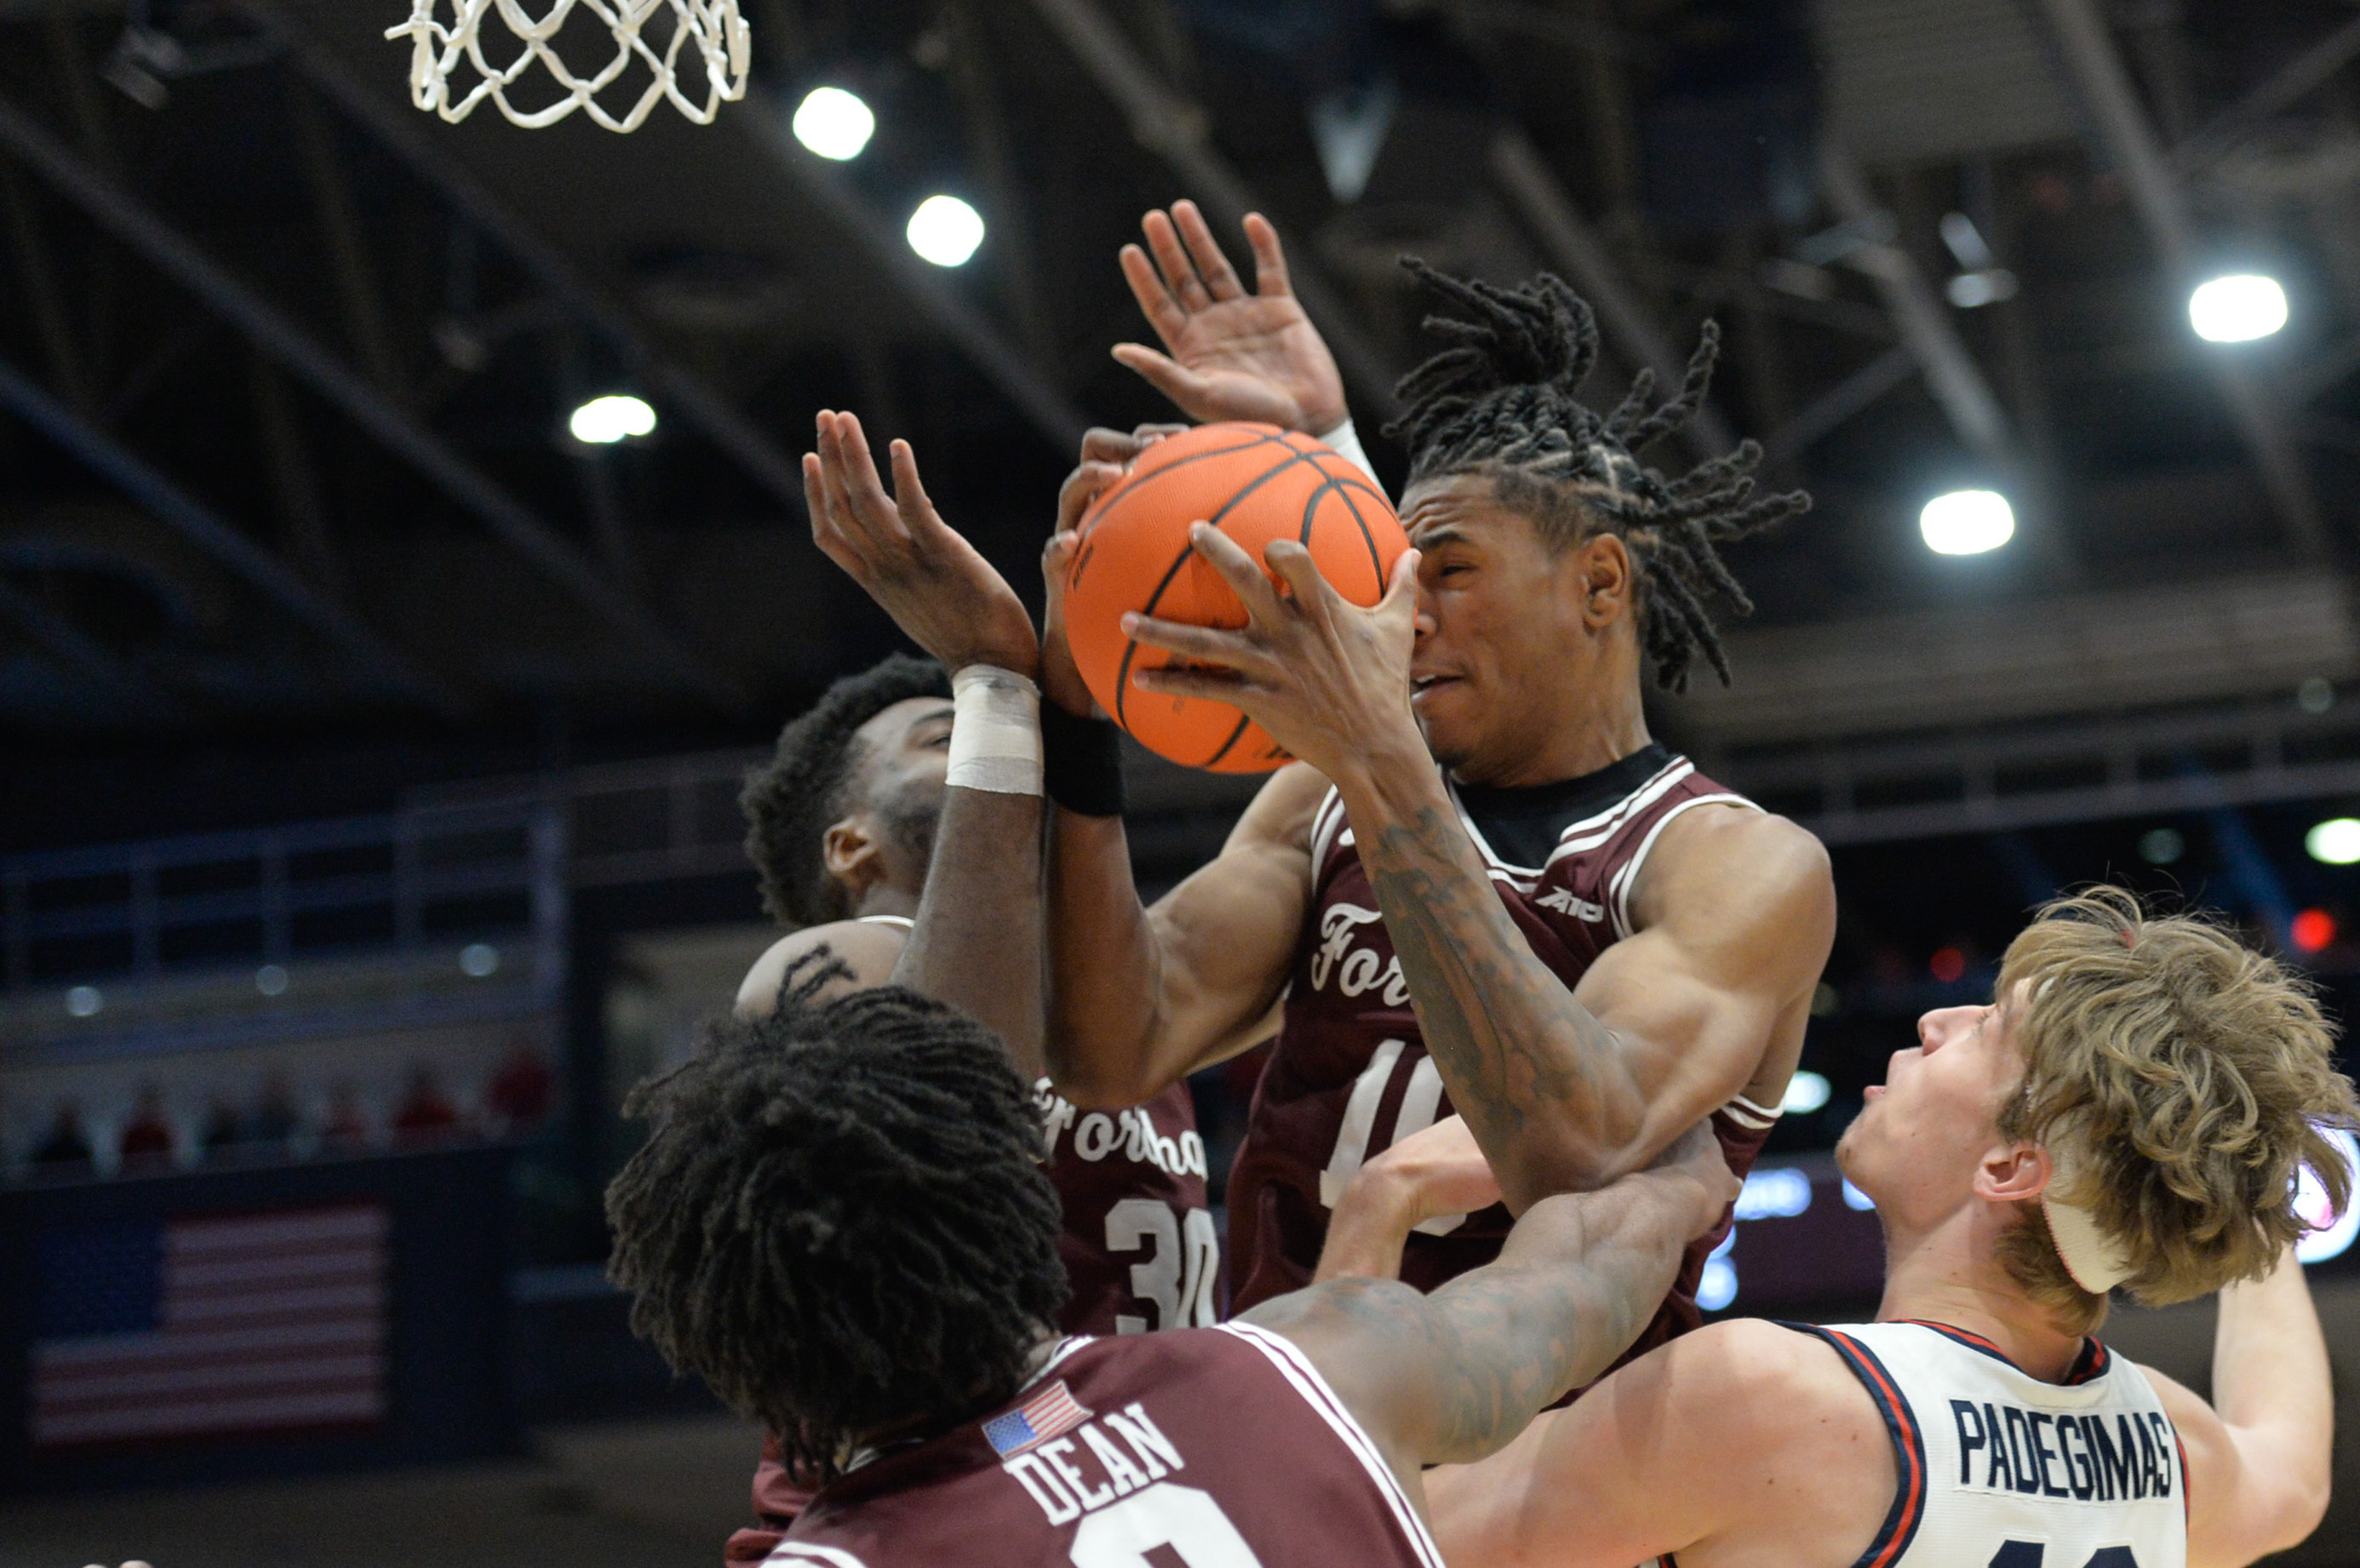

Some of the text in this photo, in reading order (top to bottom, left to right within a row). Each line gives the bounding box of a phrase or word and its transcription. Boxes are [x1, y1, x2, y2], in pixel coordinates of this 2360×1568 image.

[1104, 1199, 1220, 1335] 30
[1003, 1403, 1184, 1526] DEAN
[1949, 1399, 2171, 1502] PADEGIMAS
